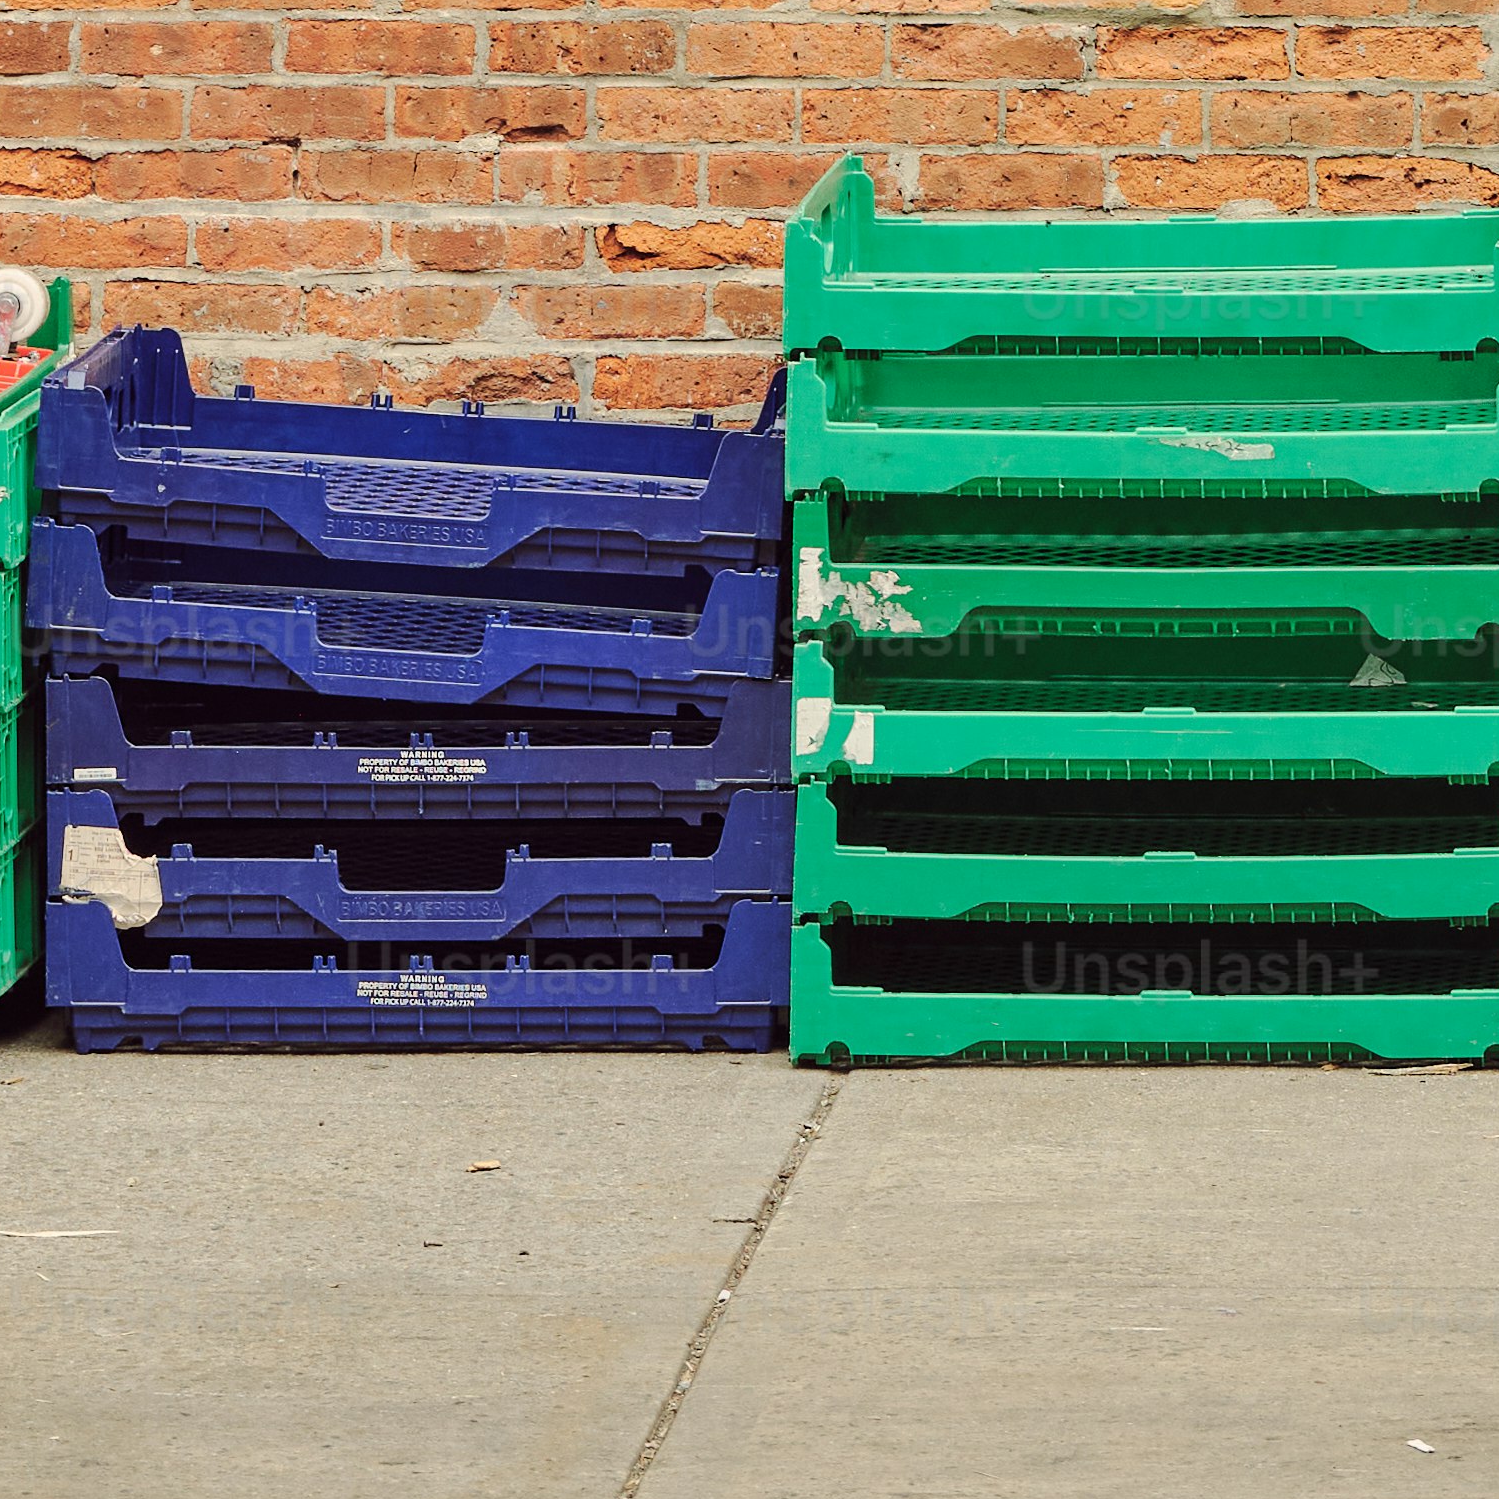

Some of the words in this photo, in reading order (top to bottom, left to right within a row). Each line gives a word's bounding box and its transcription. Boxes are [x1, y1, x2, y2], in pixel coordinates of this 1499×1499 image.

[326, 519, 374, 537] BIMBO
[378, 523, 450, 542] BAKERIES
[454, 528, 486, 543] USA
[369, 658, 442, 677] BAKERIES
[401, 751, 445, 759] WARNING
[434, 759, 470, 767] BAKERIES
[470, 759, 486, 767] USA
[342, 901, 389, 916] BIMBO
[394, 901, 466, 916] BAKERIES
[471, 901, 503, 916] USA
[400, 975, 445, 983] WARNING
[359, 982, 398, 990] PROPERTY
[435, 983, 470, 991] BAKERIES
[471, 984, 486, 992] USA
[391, 990, 418, 998] RESALE
[424, 990, 448, 998] REUSE
[454, 991, 487, 999] REGRIND
